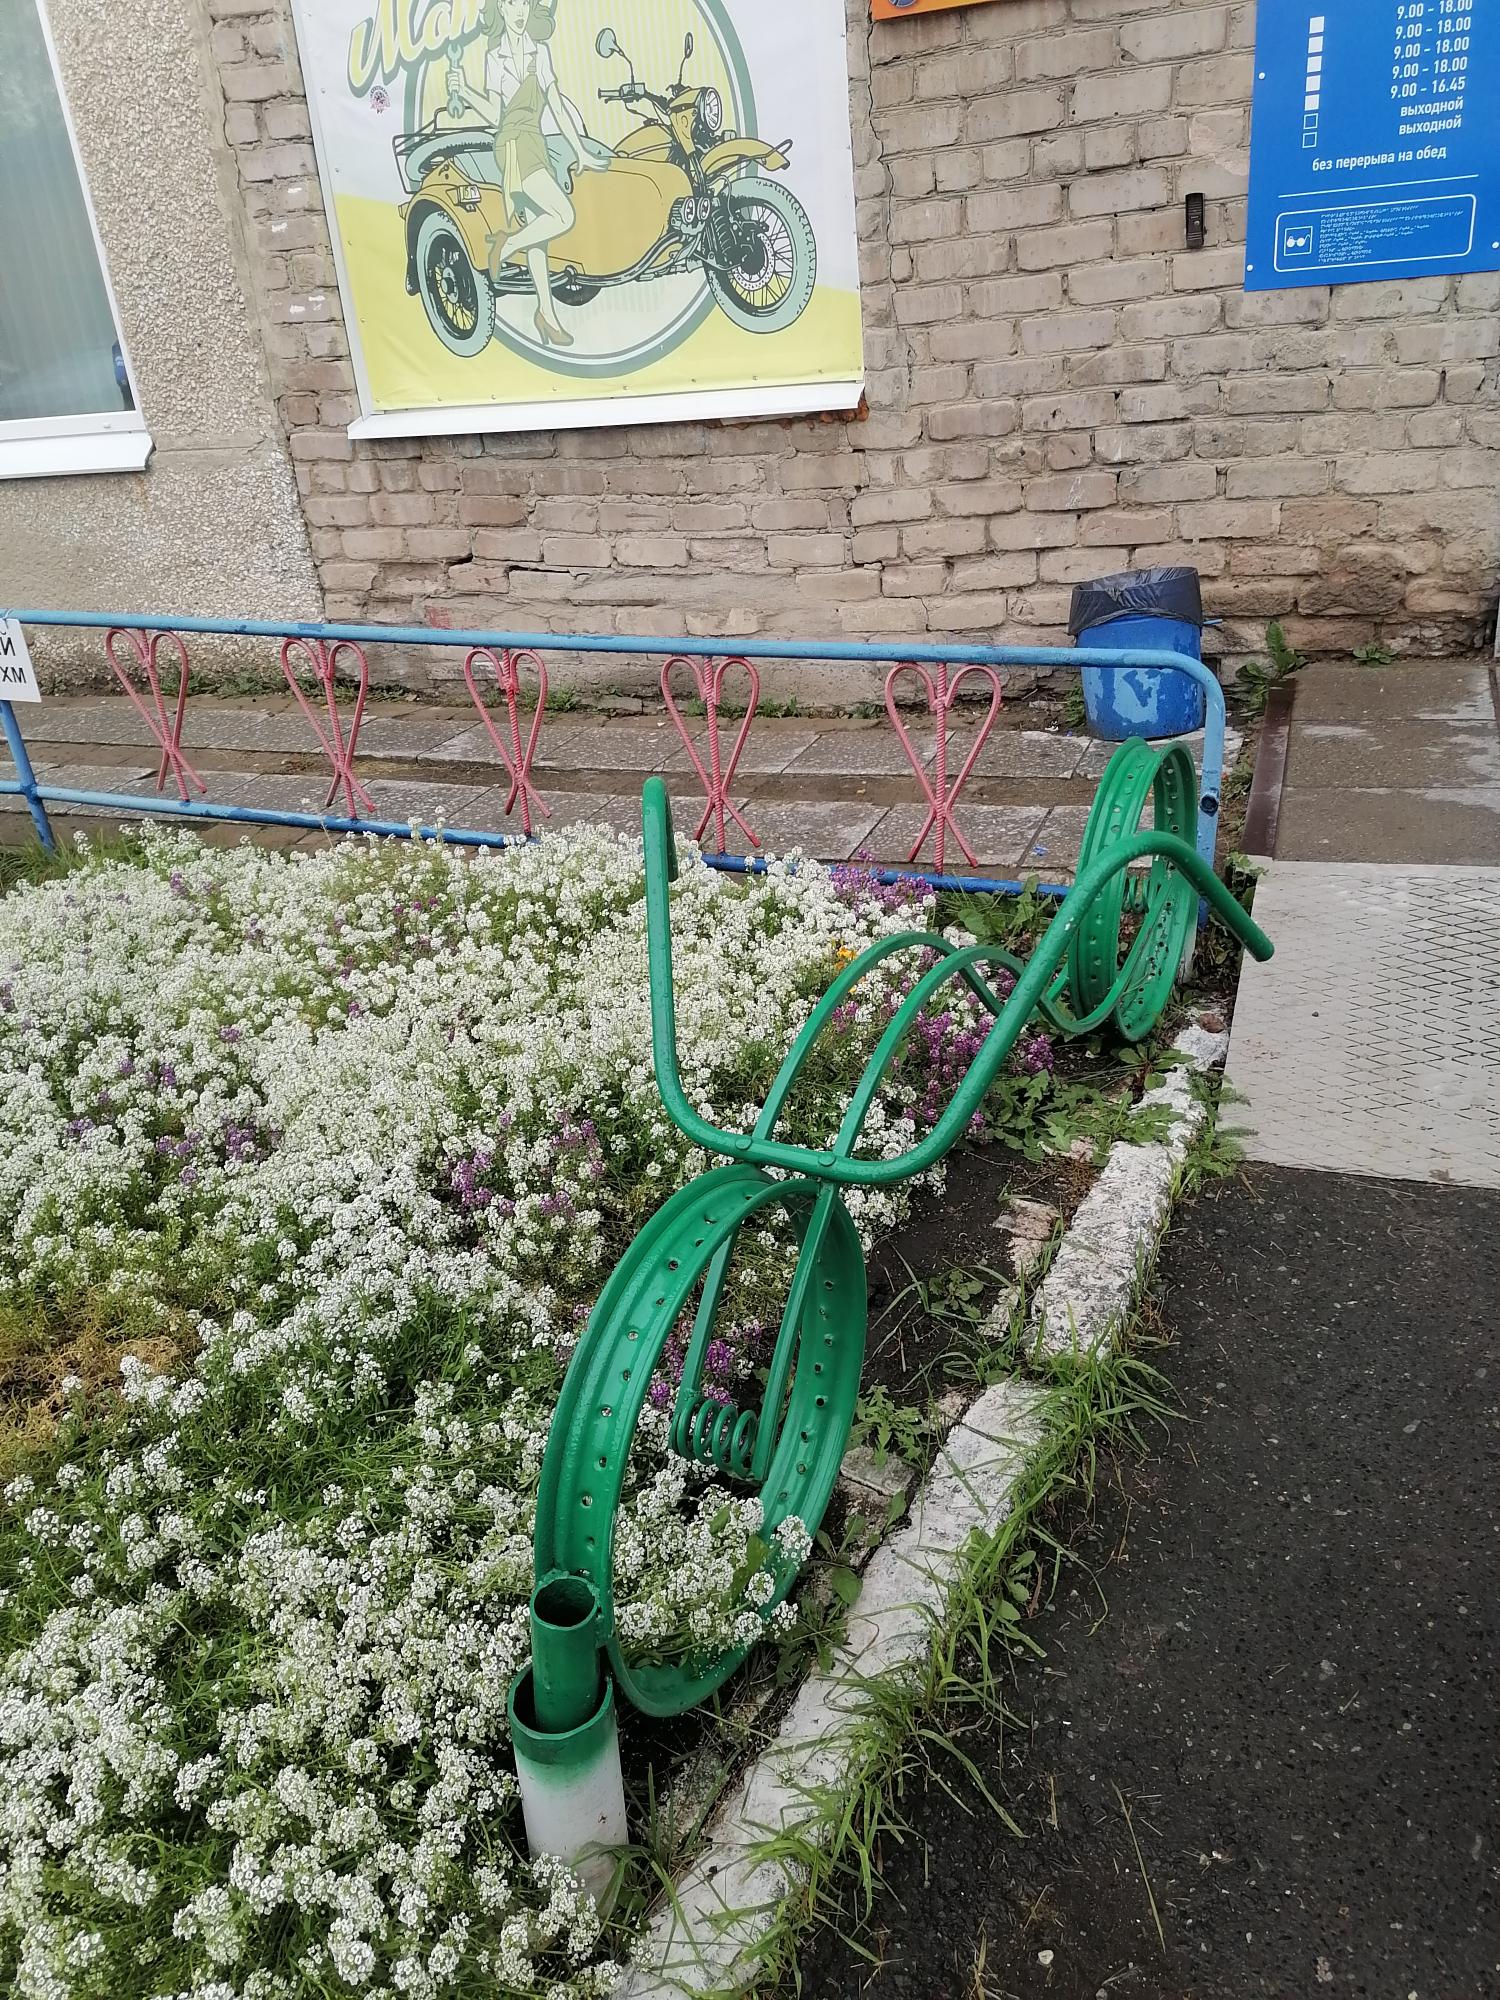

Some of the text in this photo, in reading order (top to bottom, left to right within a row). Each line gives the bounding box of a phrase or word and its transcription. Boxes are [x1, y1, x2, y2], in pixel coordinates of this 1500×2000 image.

[1397, 3, 1424, 20] 9.00
[1439, 0, 1473, 14] 18.00
[1395, 23, 1422, 40] 9.00
[1437, 17, 1471, 34] 18.00
[1394, 43, 1421, 60] 9.00
[1436, 37, 1470, 54] 18.00
[1392, 63, 1419, 80] 9.00
[1434, 56, 1468, 74] 18.00
[1390, 82, 1417, 99] 9.00
[1432, 76, 1466, 94] 16.45
[1400, 96, 1464, 117] выходной
[1398, 115, 1462, 135] выходной
[1312, 145, 1447, 171] без перерыва на обед
